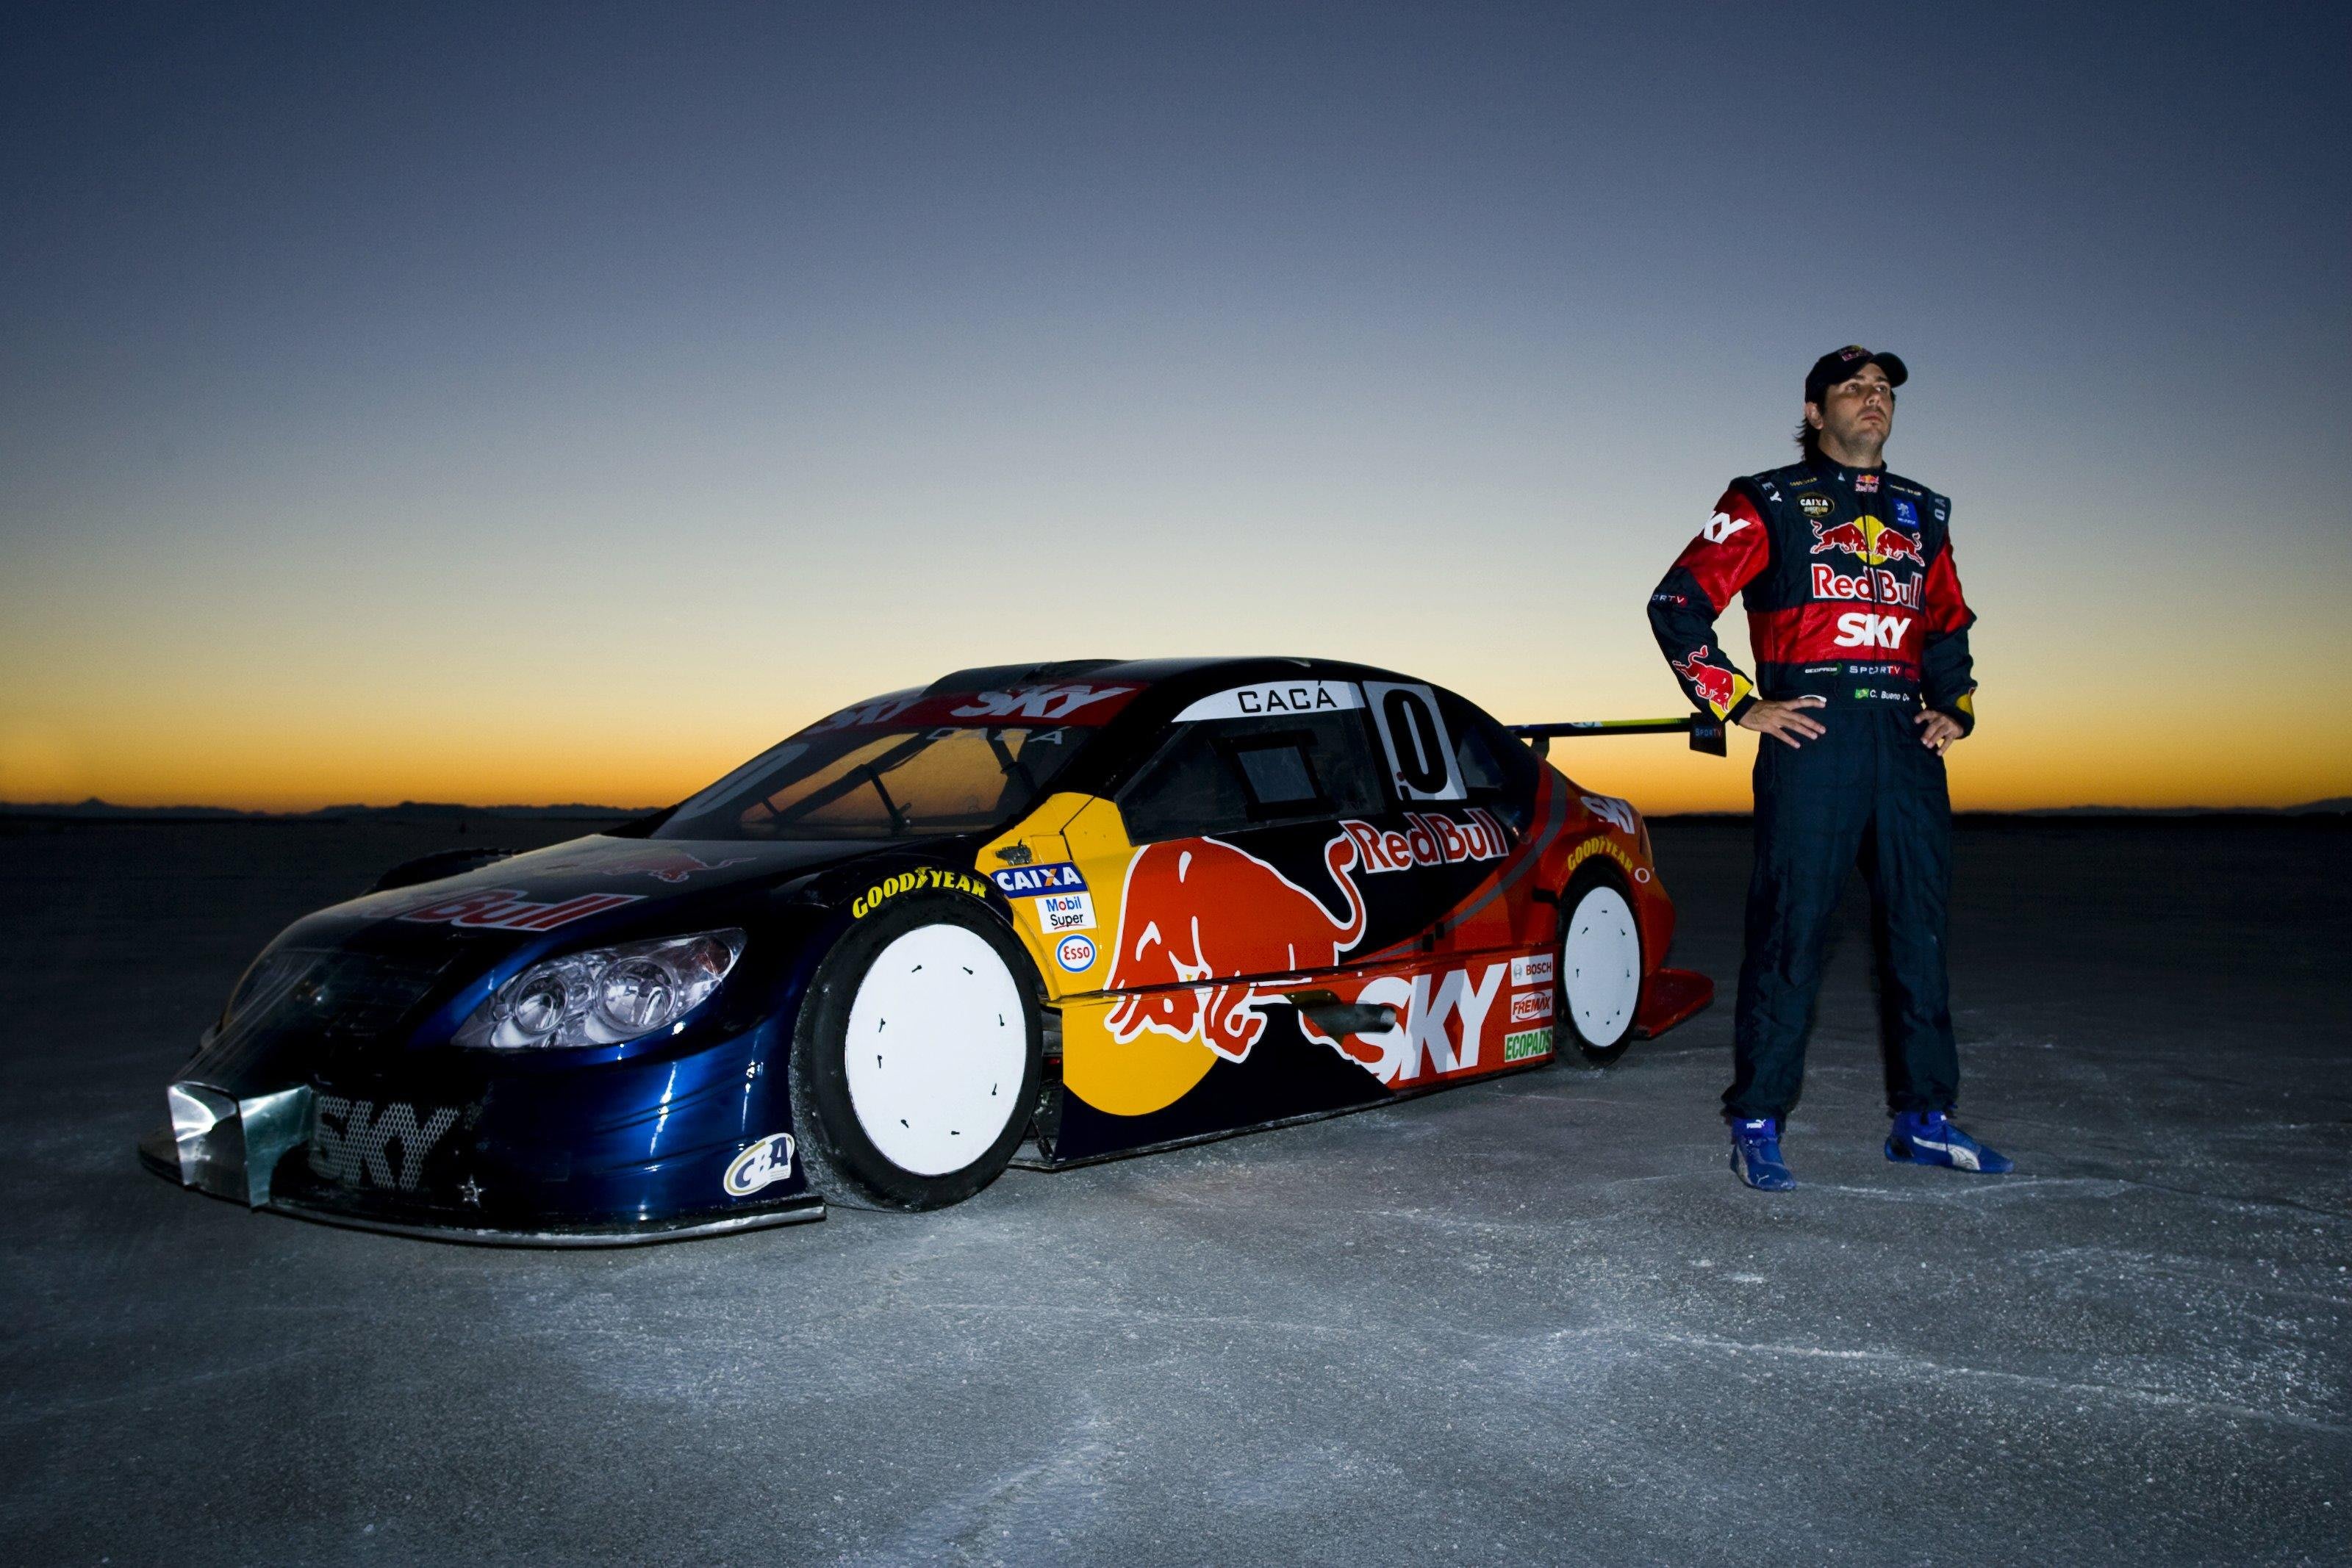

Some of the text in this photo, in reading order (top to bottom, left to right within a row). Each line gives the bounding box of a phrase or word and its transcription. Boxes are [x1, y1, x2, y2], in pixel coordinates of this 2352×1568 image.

[1800, 498, 1829, 507] CAIXA
[1811, 563, 1923, 611] Red Bull
[1834, 612, 1912, 650] SKY
[950, 683, 1136, 719] SKY
[1238, 680, 1337, 713] CACÁ
[1881, 691, 1901, 701] Bueno
[1383, 688, 1448, 794] 0
[1338, 808, 1509, 874] Red Bull
[996, 866, 1083, 891] CAIXA
[395, 889, 650, 932] Bull
[1046, 896, 1082, 913] Mobil
[1050, 913, 1083, 927] Super
[1526, 962, 1552, 976] BOSCH
[1513, 996, 1551, 1015] FREMAX
[1353, 963, 1508, 1085] SKY
[1505, 1029, 1552, 1060] ECOPADS
[308, 1096, 462, 1193] SKY
[735, 1137, 789, 1188] CBA
